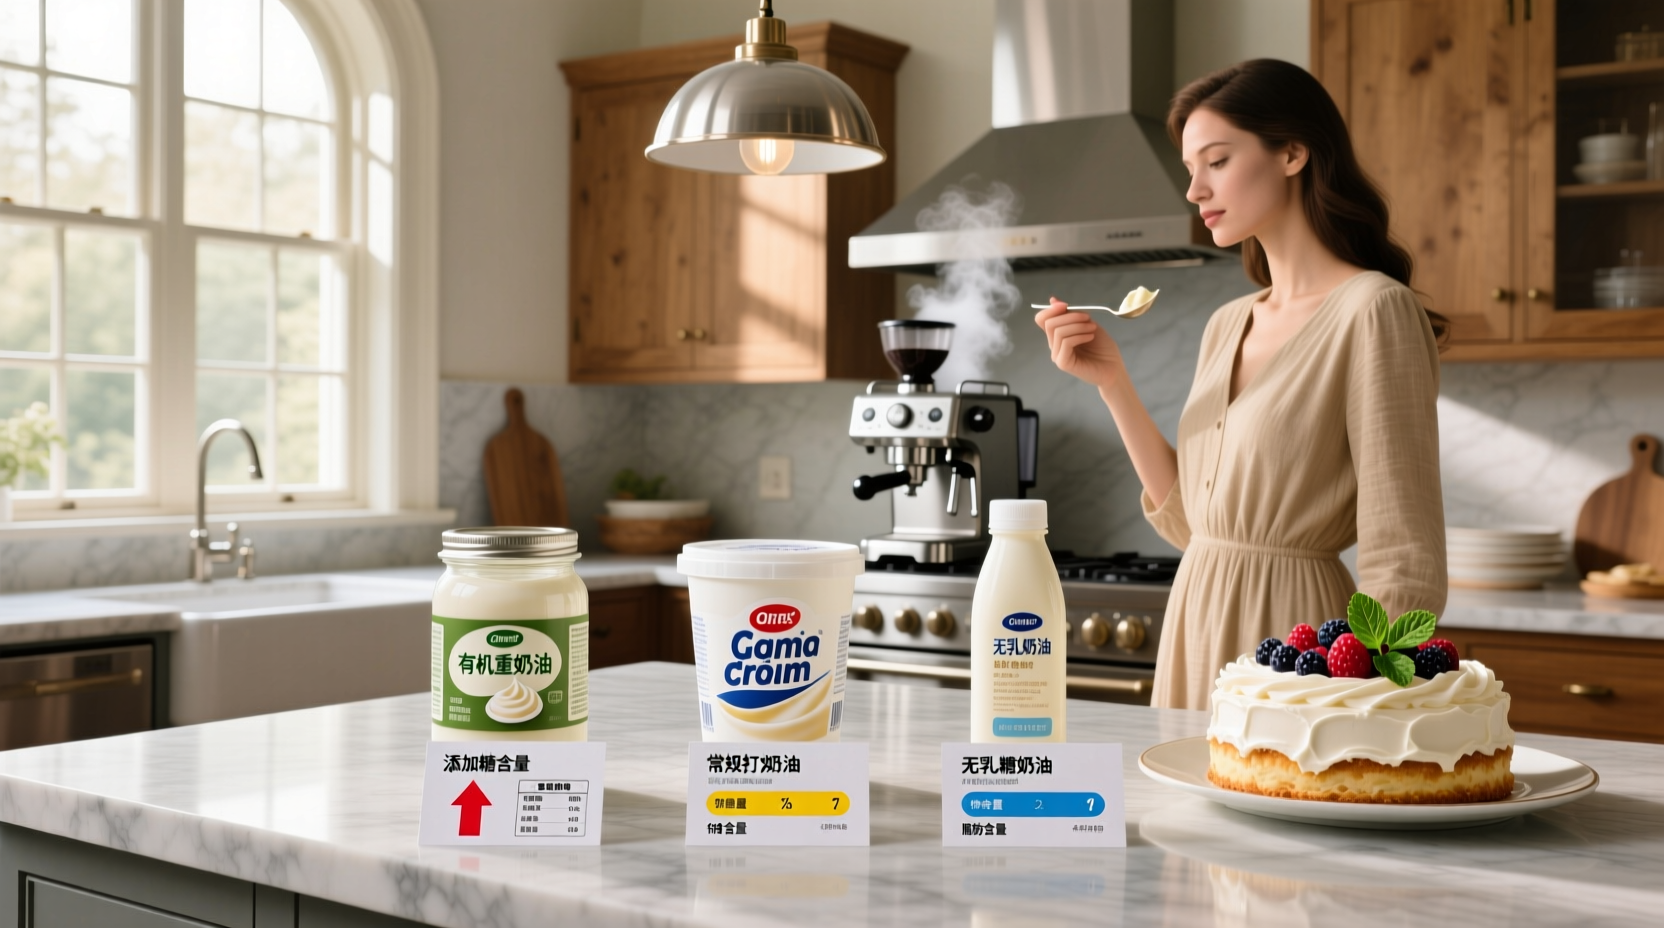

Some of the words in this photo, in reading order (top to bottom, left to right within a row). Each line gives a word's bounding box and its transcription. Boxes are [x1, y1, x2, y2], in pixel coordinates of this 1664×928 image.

[458, 652, 552, 675] 有机重奶油
[443, 753, 531, 773] 添加糖含量
